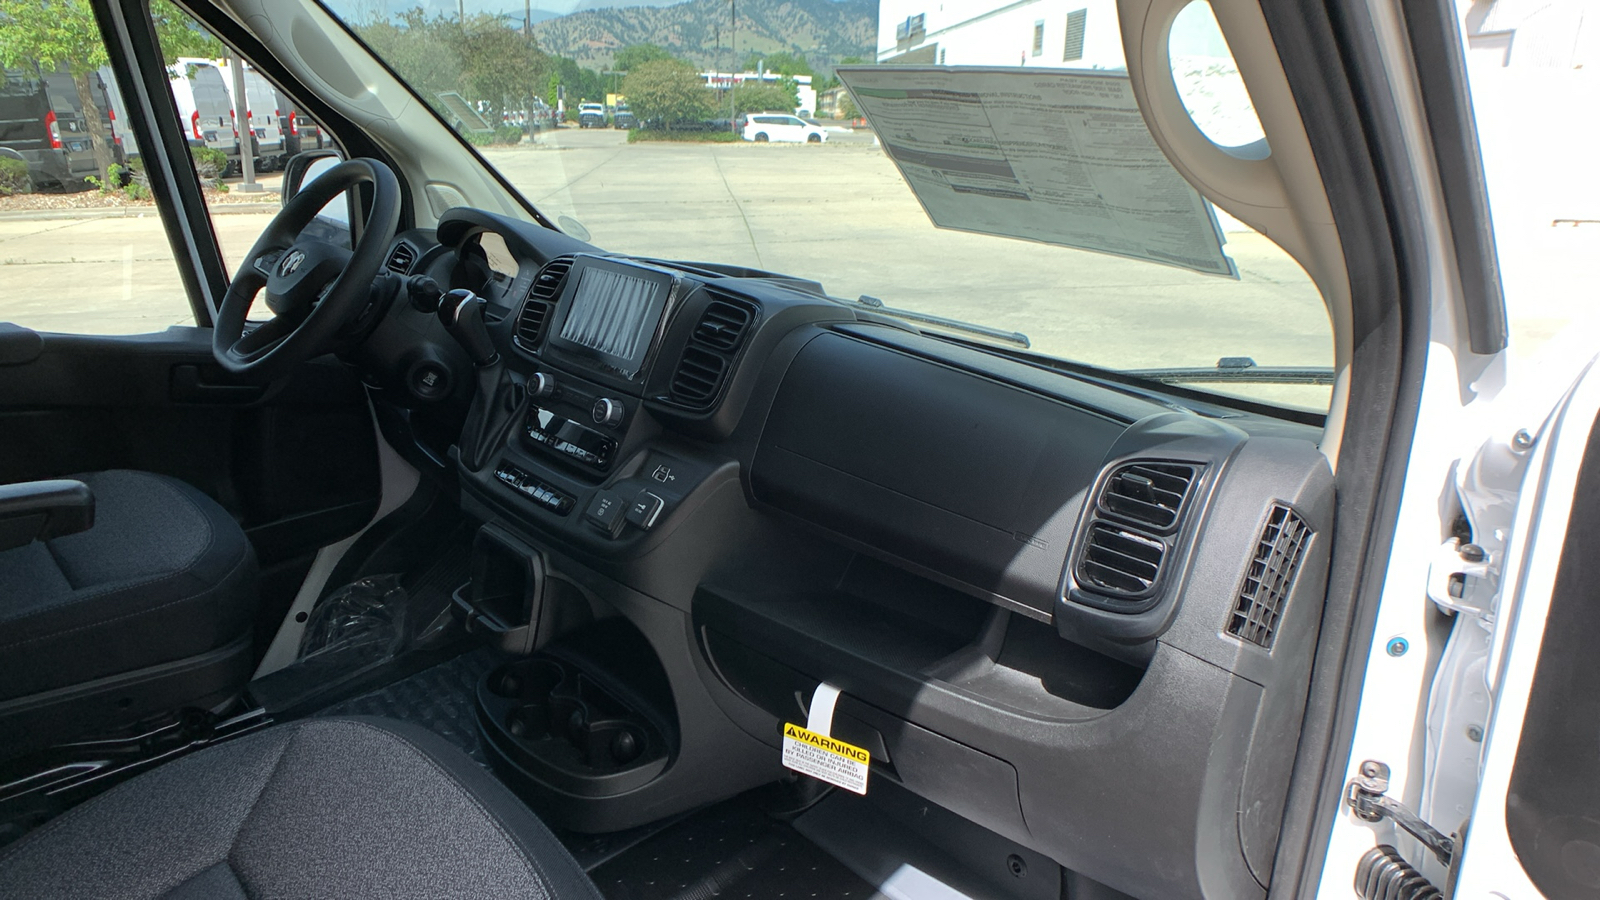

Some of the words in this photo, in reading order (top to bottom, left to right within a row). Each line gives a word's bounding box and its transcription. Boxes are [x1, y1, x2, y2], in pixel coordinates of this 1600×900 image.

[792, 745, 815, 758] KILLED
[816, 753, 826, 762] OR
[827, 758, 858, 773] INJURED
[794, 740, 829, 757] CHILDREN
[829, 752, 845, 763] CAN
[847, 758, 856, 766] BE
[798, 730, 867, 761] WARNING
[785, 748, 794, 756] BY
[796, 752, 836, 771] PASSENGER
[838, 767, 864, 781] AIRBAG
